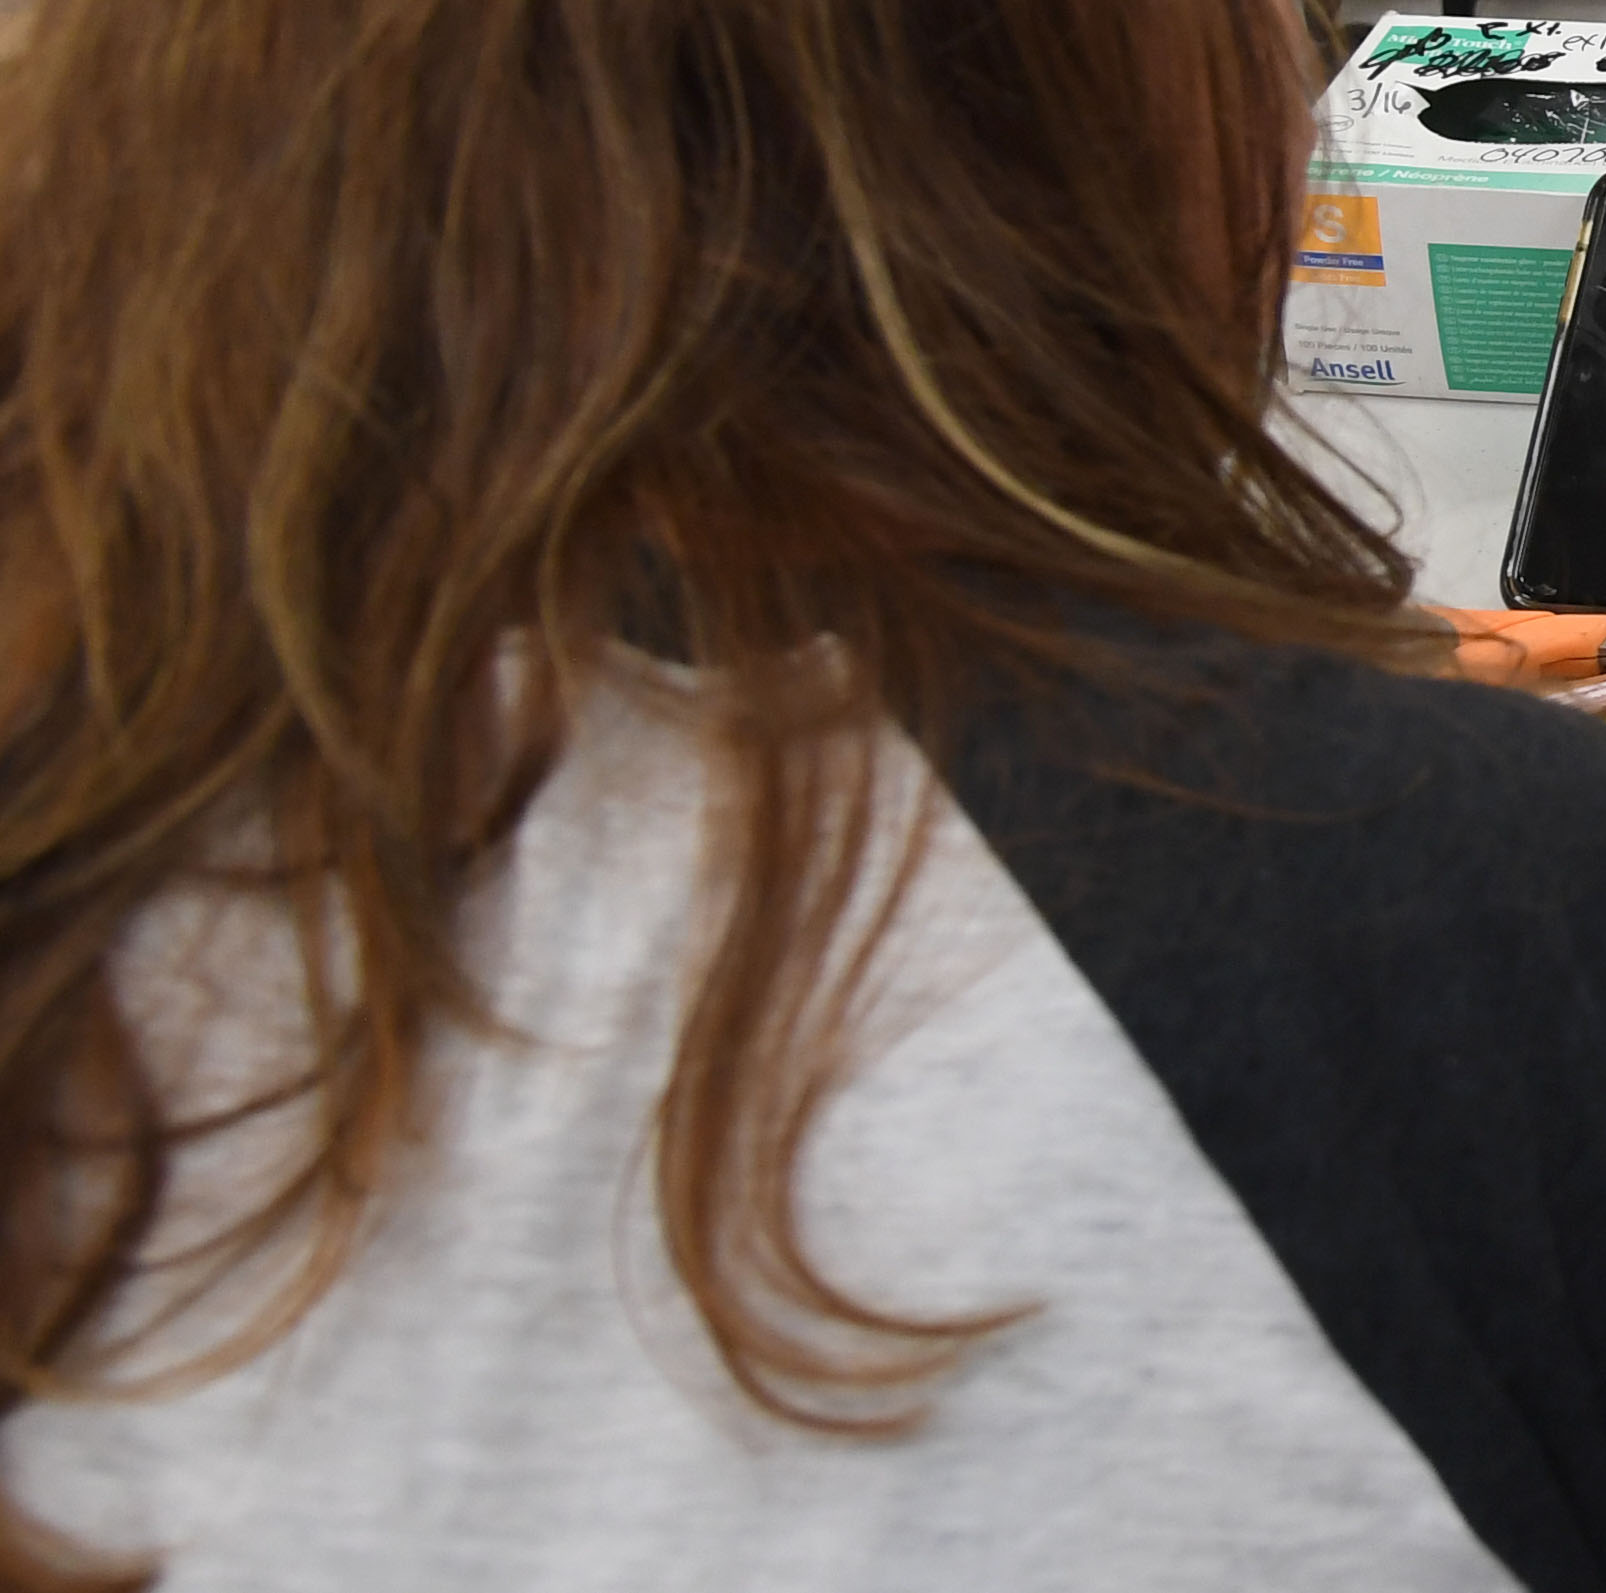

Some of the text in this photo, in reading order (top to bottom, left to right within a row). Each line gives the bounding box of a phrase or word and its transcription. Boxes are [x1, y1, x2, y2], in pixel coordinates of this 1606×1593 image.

[1313, 204, 1346, 243] S
[1342, 256, 1364, 267] Free
[1310, 357, 1396, 381] Ansell
